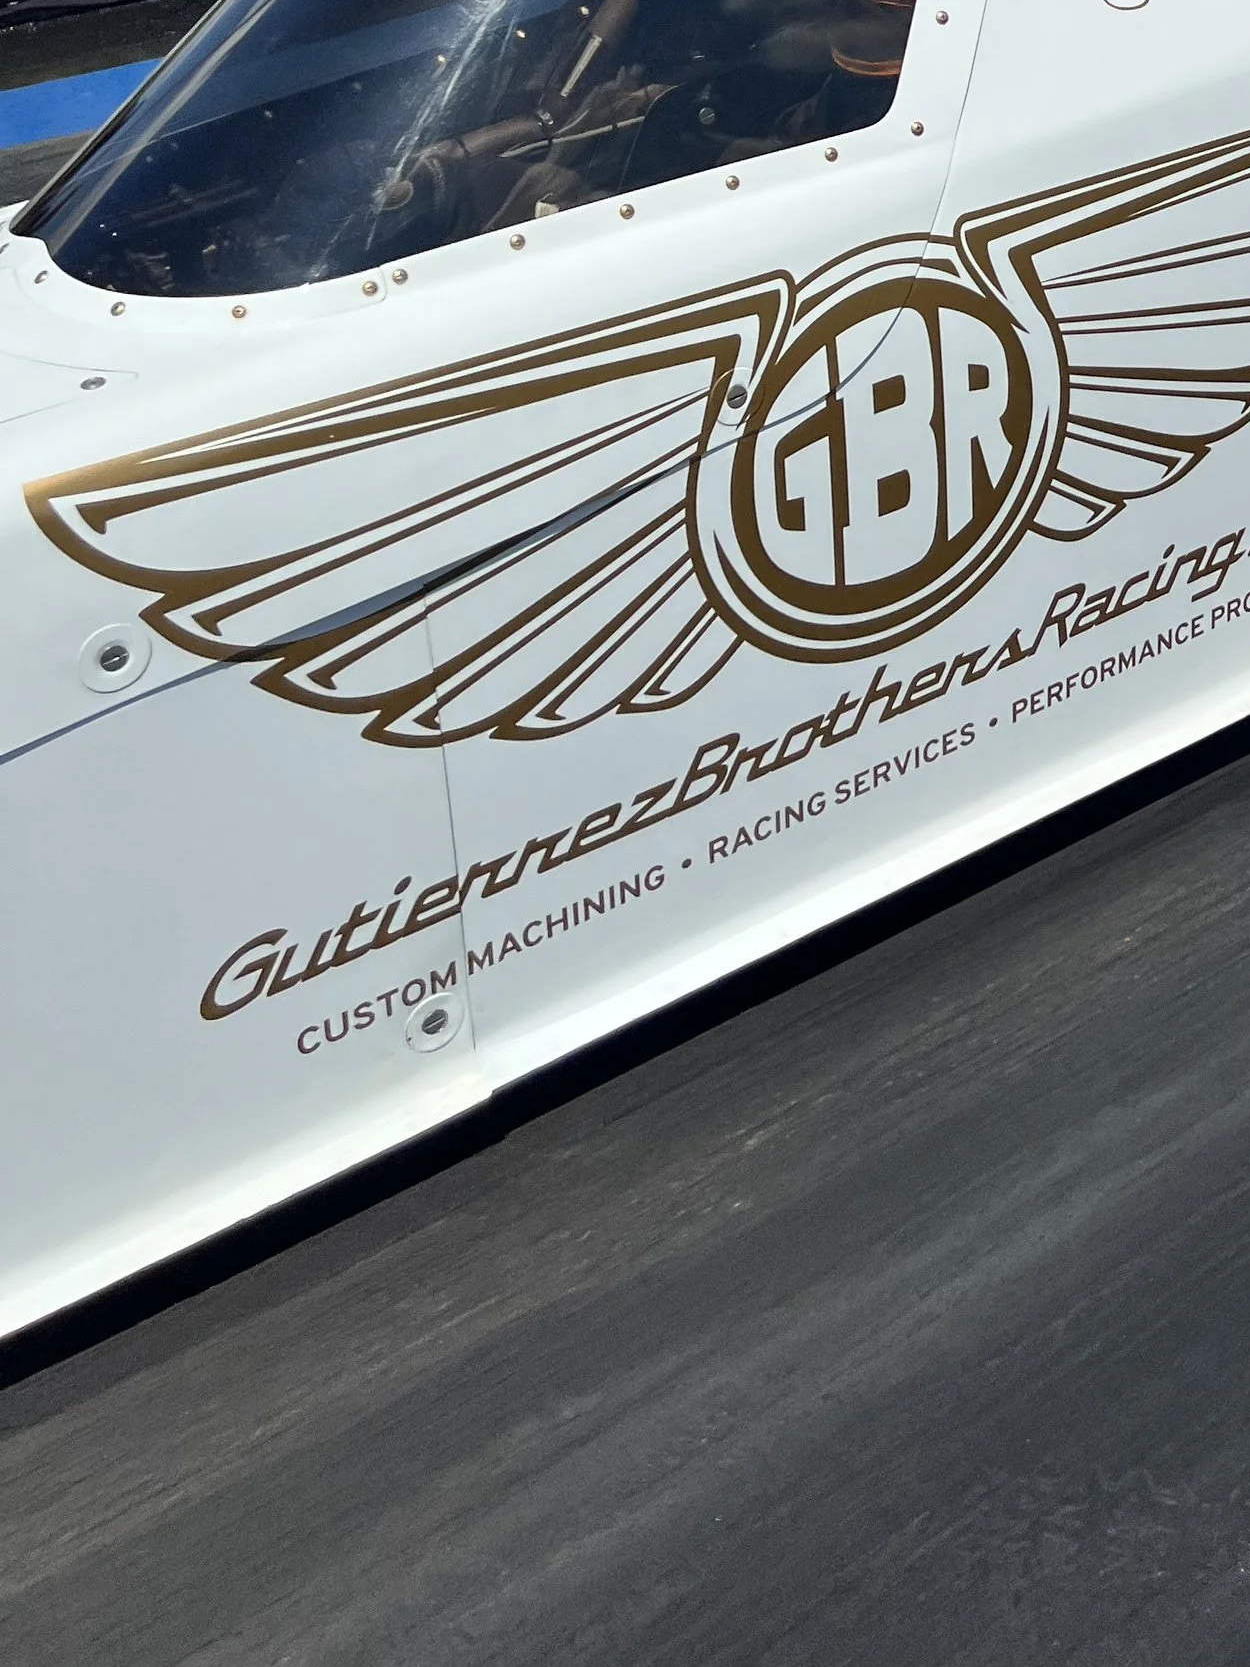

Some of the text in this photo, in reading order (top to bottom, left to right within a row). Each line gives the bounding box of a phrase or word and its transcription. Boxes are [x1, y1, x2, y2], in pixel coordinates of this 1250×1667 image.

[752, 305, 1014, 587] GBR
[296, 961, 457, 1055] CUSTOM
[466, 863, 666, 975] MACHINING
[707, 791, 827, 865] RACING
[834, 721, 976, 805] SERVICES
[1010, 613, 1205, 725] PERFORMANCE
